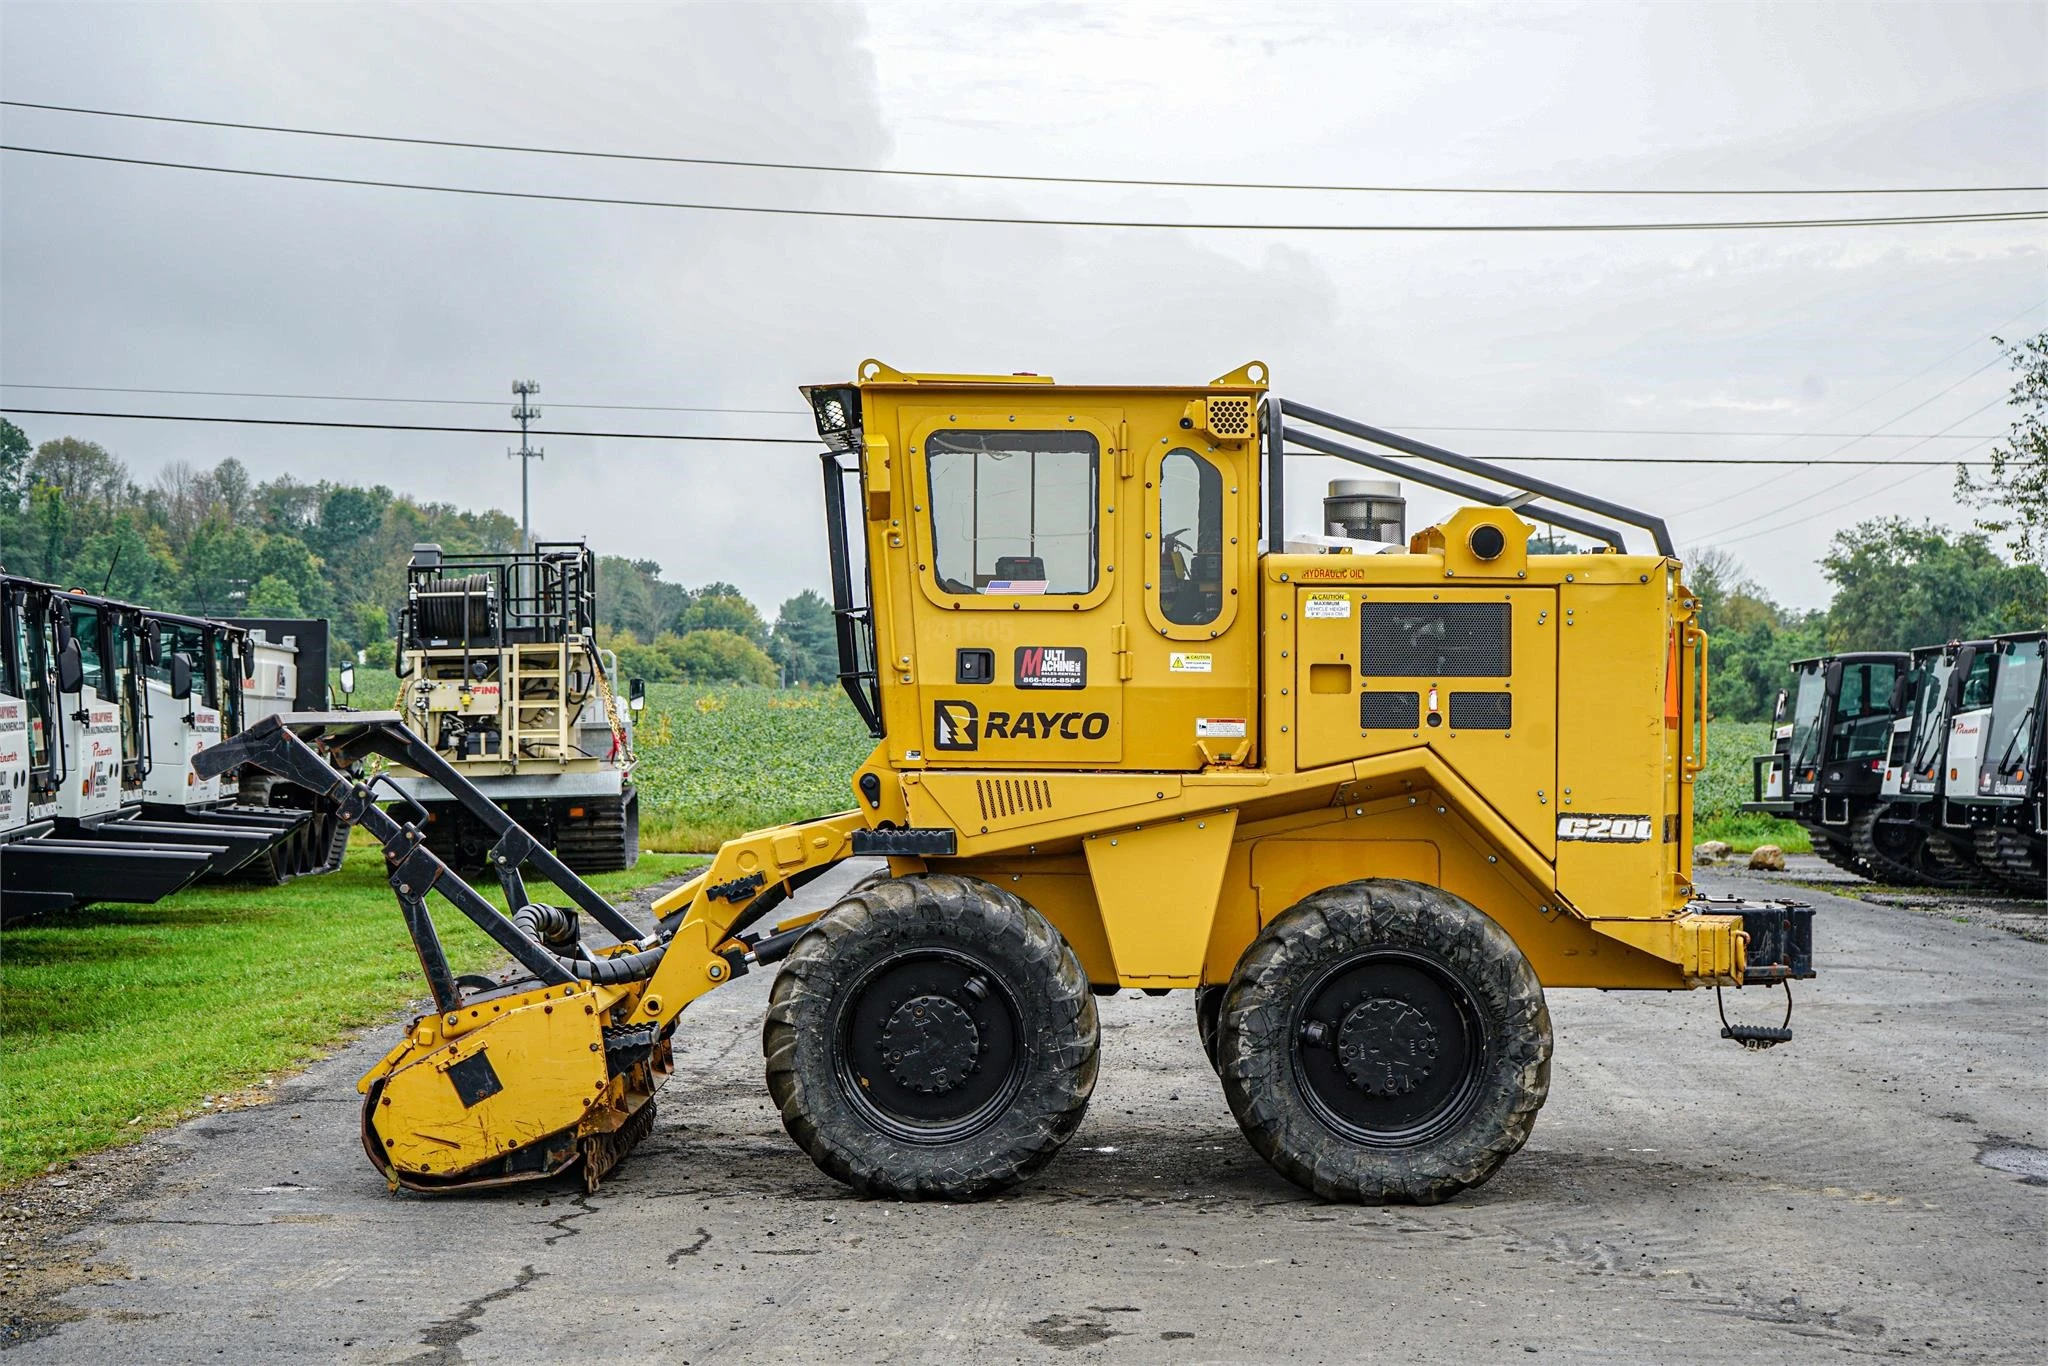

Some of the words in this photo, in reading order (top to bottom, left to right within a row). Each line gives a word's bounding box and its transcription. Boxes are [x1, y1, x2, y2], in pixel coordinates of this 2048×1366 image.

[1303, 569, 1348, 578] HYDRAULIC
[1349, 569, 1363, 578] OIL
[984, 712, 1110, 740] RAYCO
